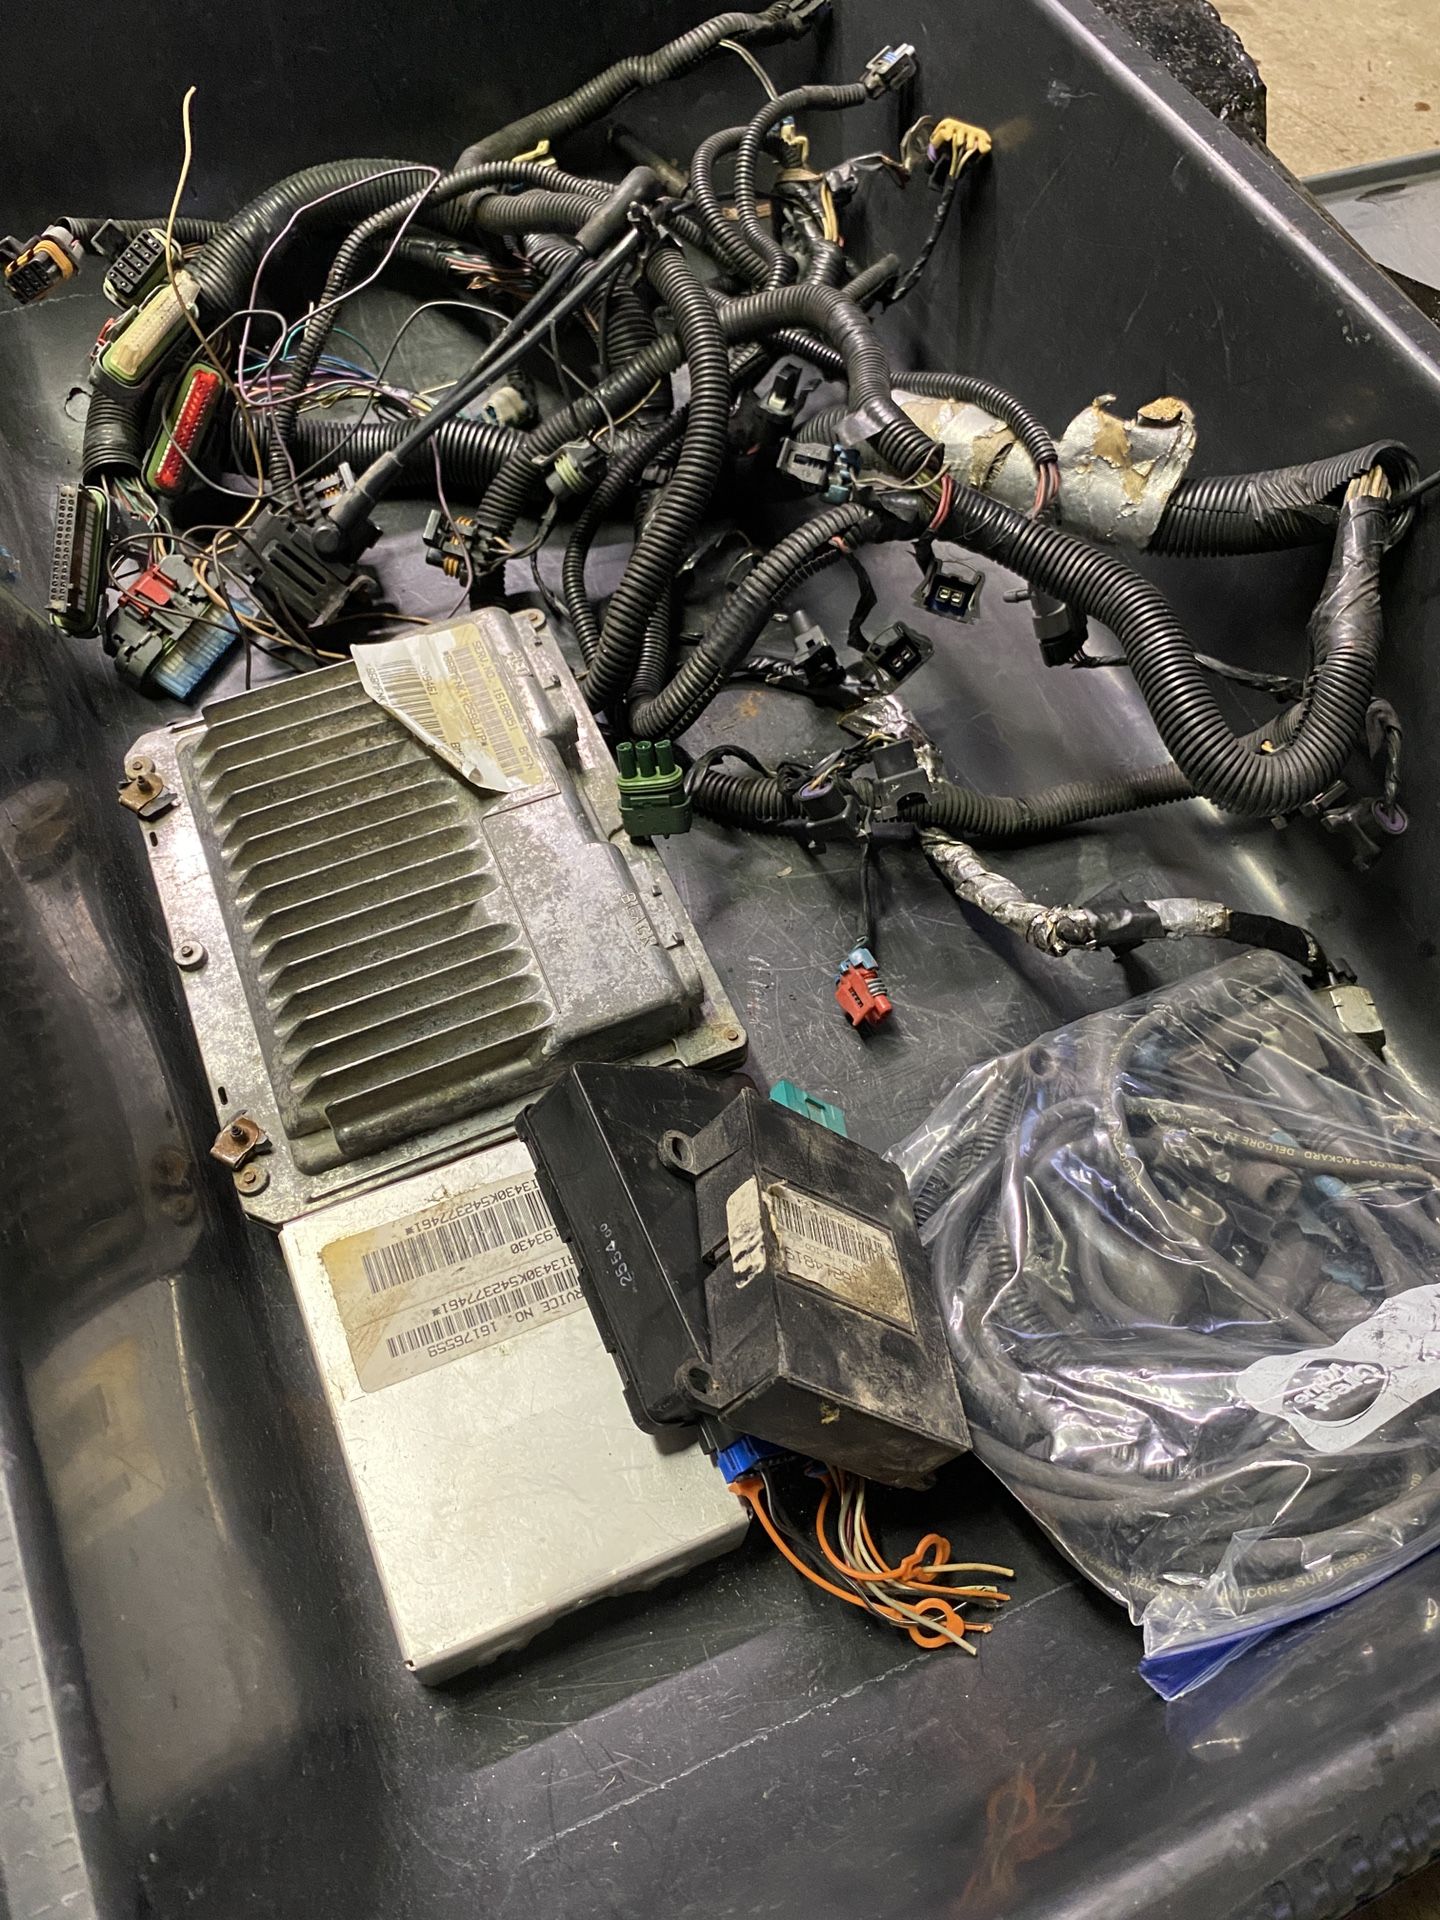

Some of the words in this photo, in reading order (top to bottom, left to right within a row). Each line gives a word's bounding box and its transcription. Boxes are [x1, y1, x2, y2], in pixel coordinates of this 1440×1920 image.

[1241, 1135, 1295, 1156] DELCORE
[405, 1178, 539, 1236] I3430K542377461
[510, 1226, 560, 1255] 193430
[605, 1239, 633, 1287] 2554
[508, 1306, 535, 1324] NO.
[542, 1288, 586, 1314] RVICE
[427, 1321, 499, 1358] 16176559
[1304, 1363, 1381, 1412] Great
